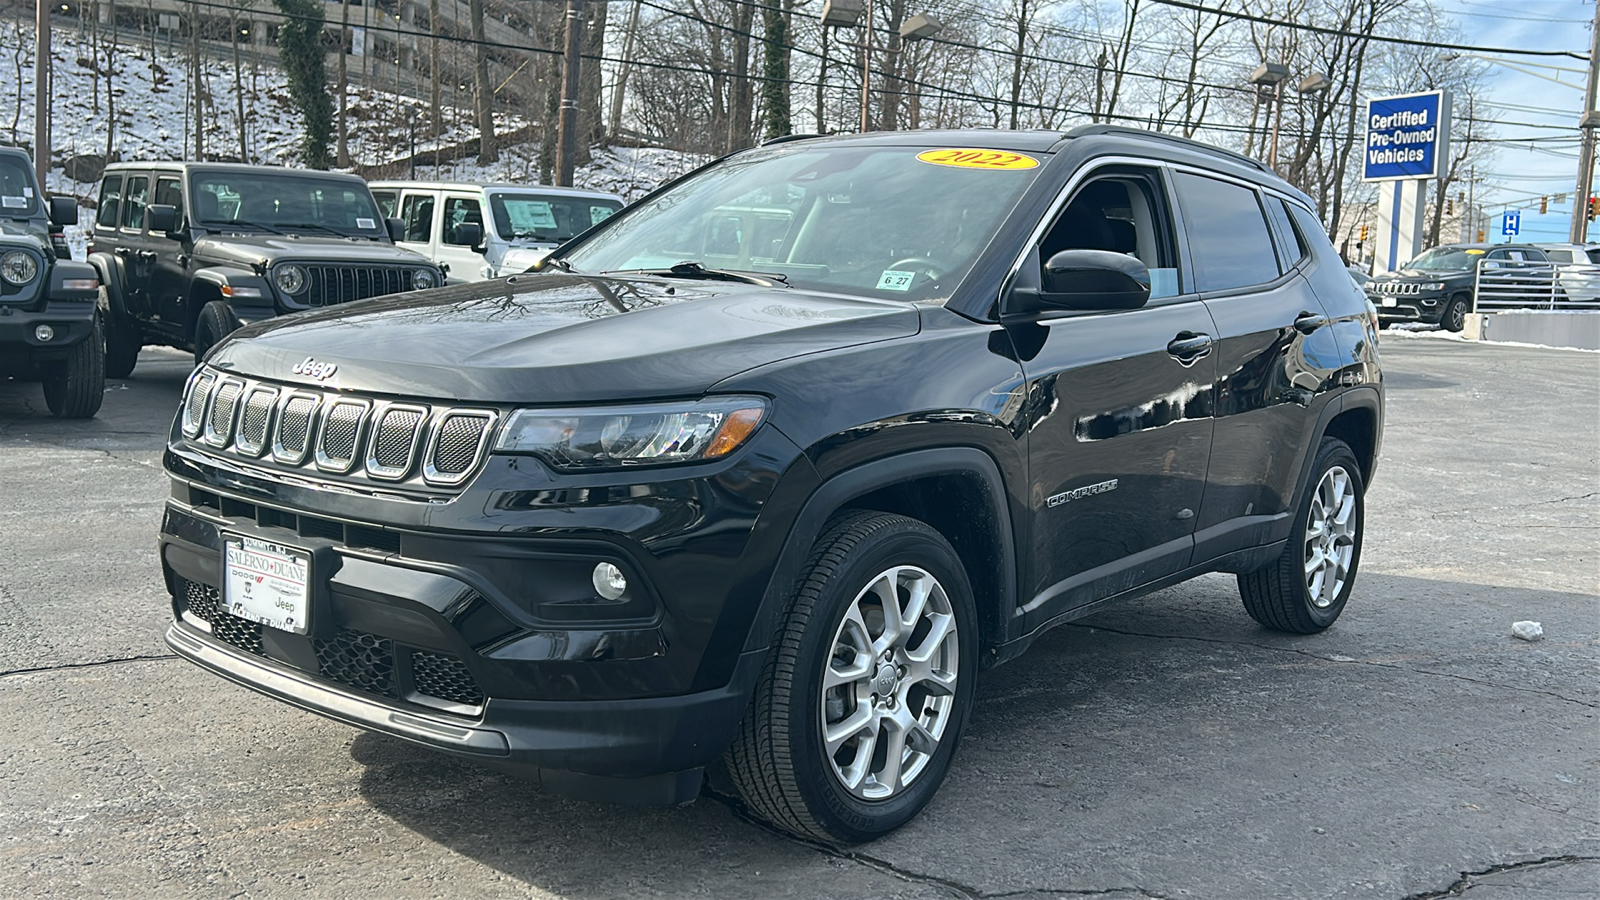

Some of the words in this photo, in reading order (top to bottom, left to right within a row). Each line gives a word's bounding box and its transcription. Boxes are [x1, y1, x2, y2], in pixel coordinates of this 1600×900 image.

[1371, 109, 1428, 129] Certified
[1369, 127, 1435, 147] Pre-Owned
[932, 151, 1022, 166] 2022
[1369, 147, 1424, 165] Vehicles
[1506, 215, 1517, 229] H
[884, 276, 892, 285] 6
[896, 277, 909, 286] 27
[291, 356, 338, 381] Jeep
[1046, 478, 1119, 508] COMPASS
[228, 550, 269, 571] SALERNO
[274, 561, 306, 582] DUANE
[275, 596, 295, 614] Jeep
